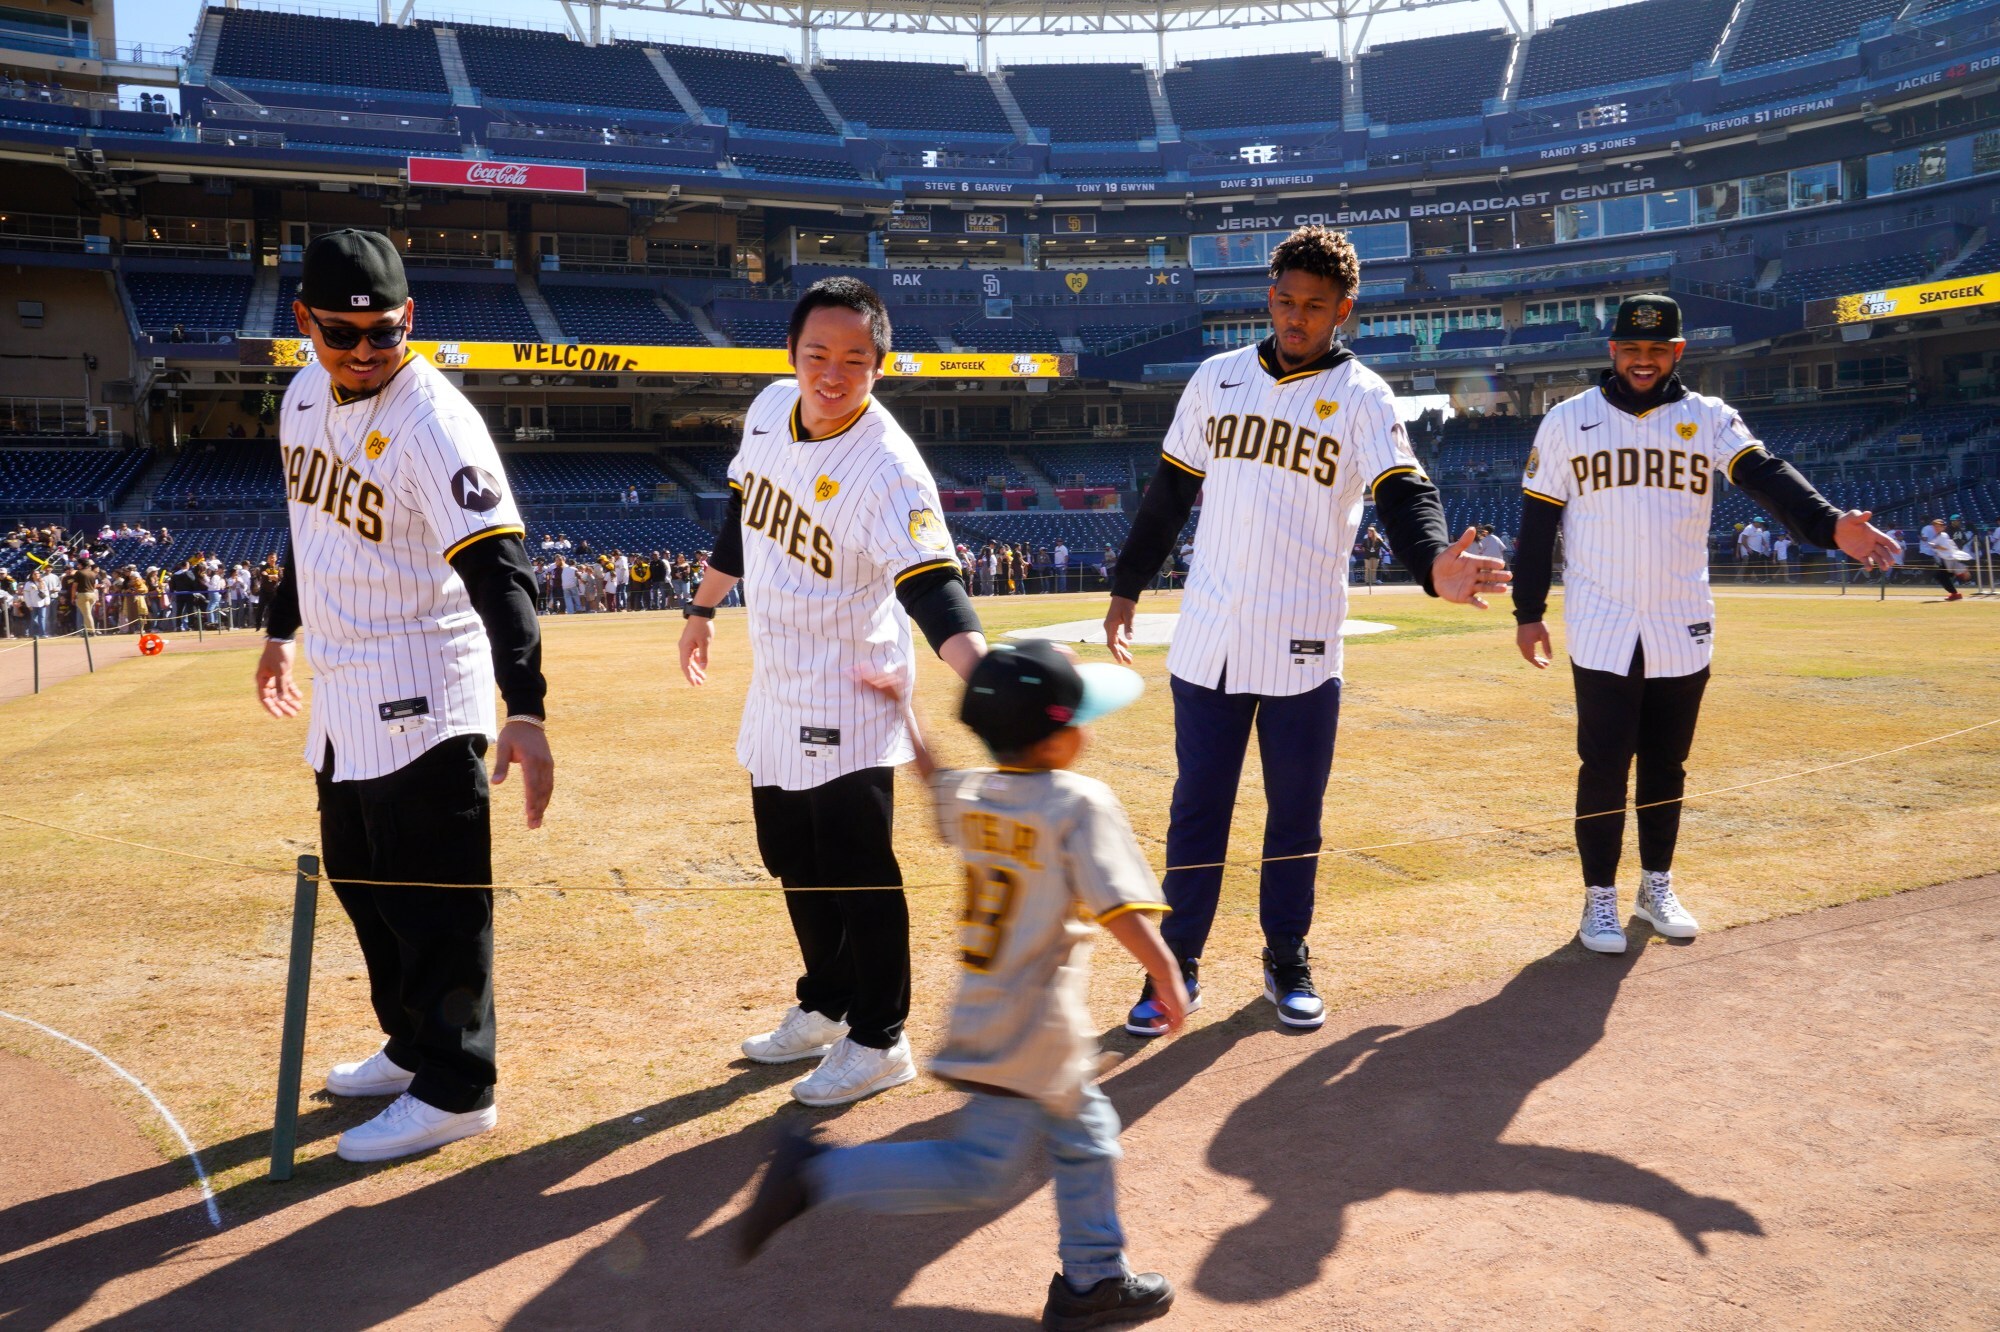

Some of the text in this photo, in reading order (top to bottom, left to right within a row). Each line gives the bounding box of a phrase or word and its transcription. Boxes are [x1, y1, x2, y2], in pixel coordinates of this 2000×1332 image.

[1894, 71, 1941, 92] JACKIE
[1946, 65, 1967, 79] 42
[1704, 98, 1834, 133] TREVOR 51 HOFFMAN
[1540, 137, 1637, 159] RANDY 35 JONES
[924, 182, 1013, 192] STEVE 6 GARVEY
[1075, 183, 1155, 193] TONY 19 GWYNN
[1220, 175, 1314, 189] DAVE 31 WINFIELD
[1216, 177, 1656, 231] JERRY COLEMAN BROADCAST CENTER
[893, 274, 922, 286] RAK
[1919, 283, 1985, 305] SEATGEEK
[1870, 300, 1897, 314] FEST
[300, 341, 315, 351] FA
[445, 354, 469, 364] FEST
[940, 360, 986, 371] SEATGEEK
[902, 363, 922, 372] FEST
[1019, 364, 1039, 373] FEST
[1319, 404, 1332, 416] PS
[1681, 427, 1692, 437] PS
[368, 437, 385, 455] PS
[1570, 448, 1710, 497] PADRES
[817, 481, 832, 498] PS
[741, 471, 833, 580] ADRES
